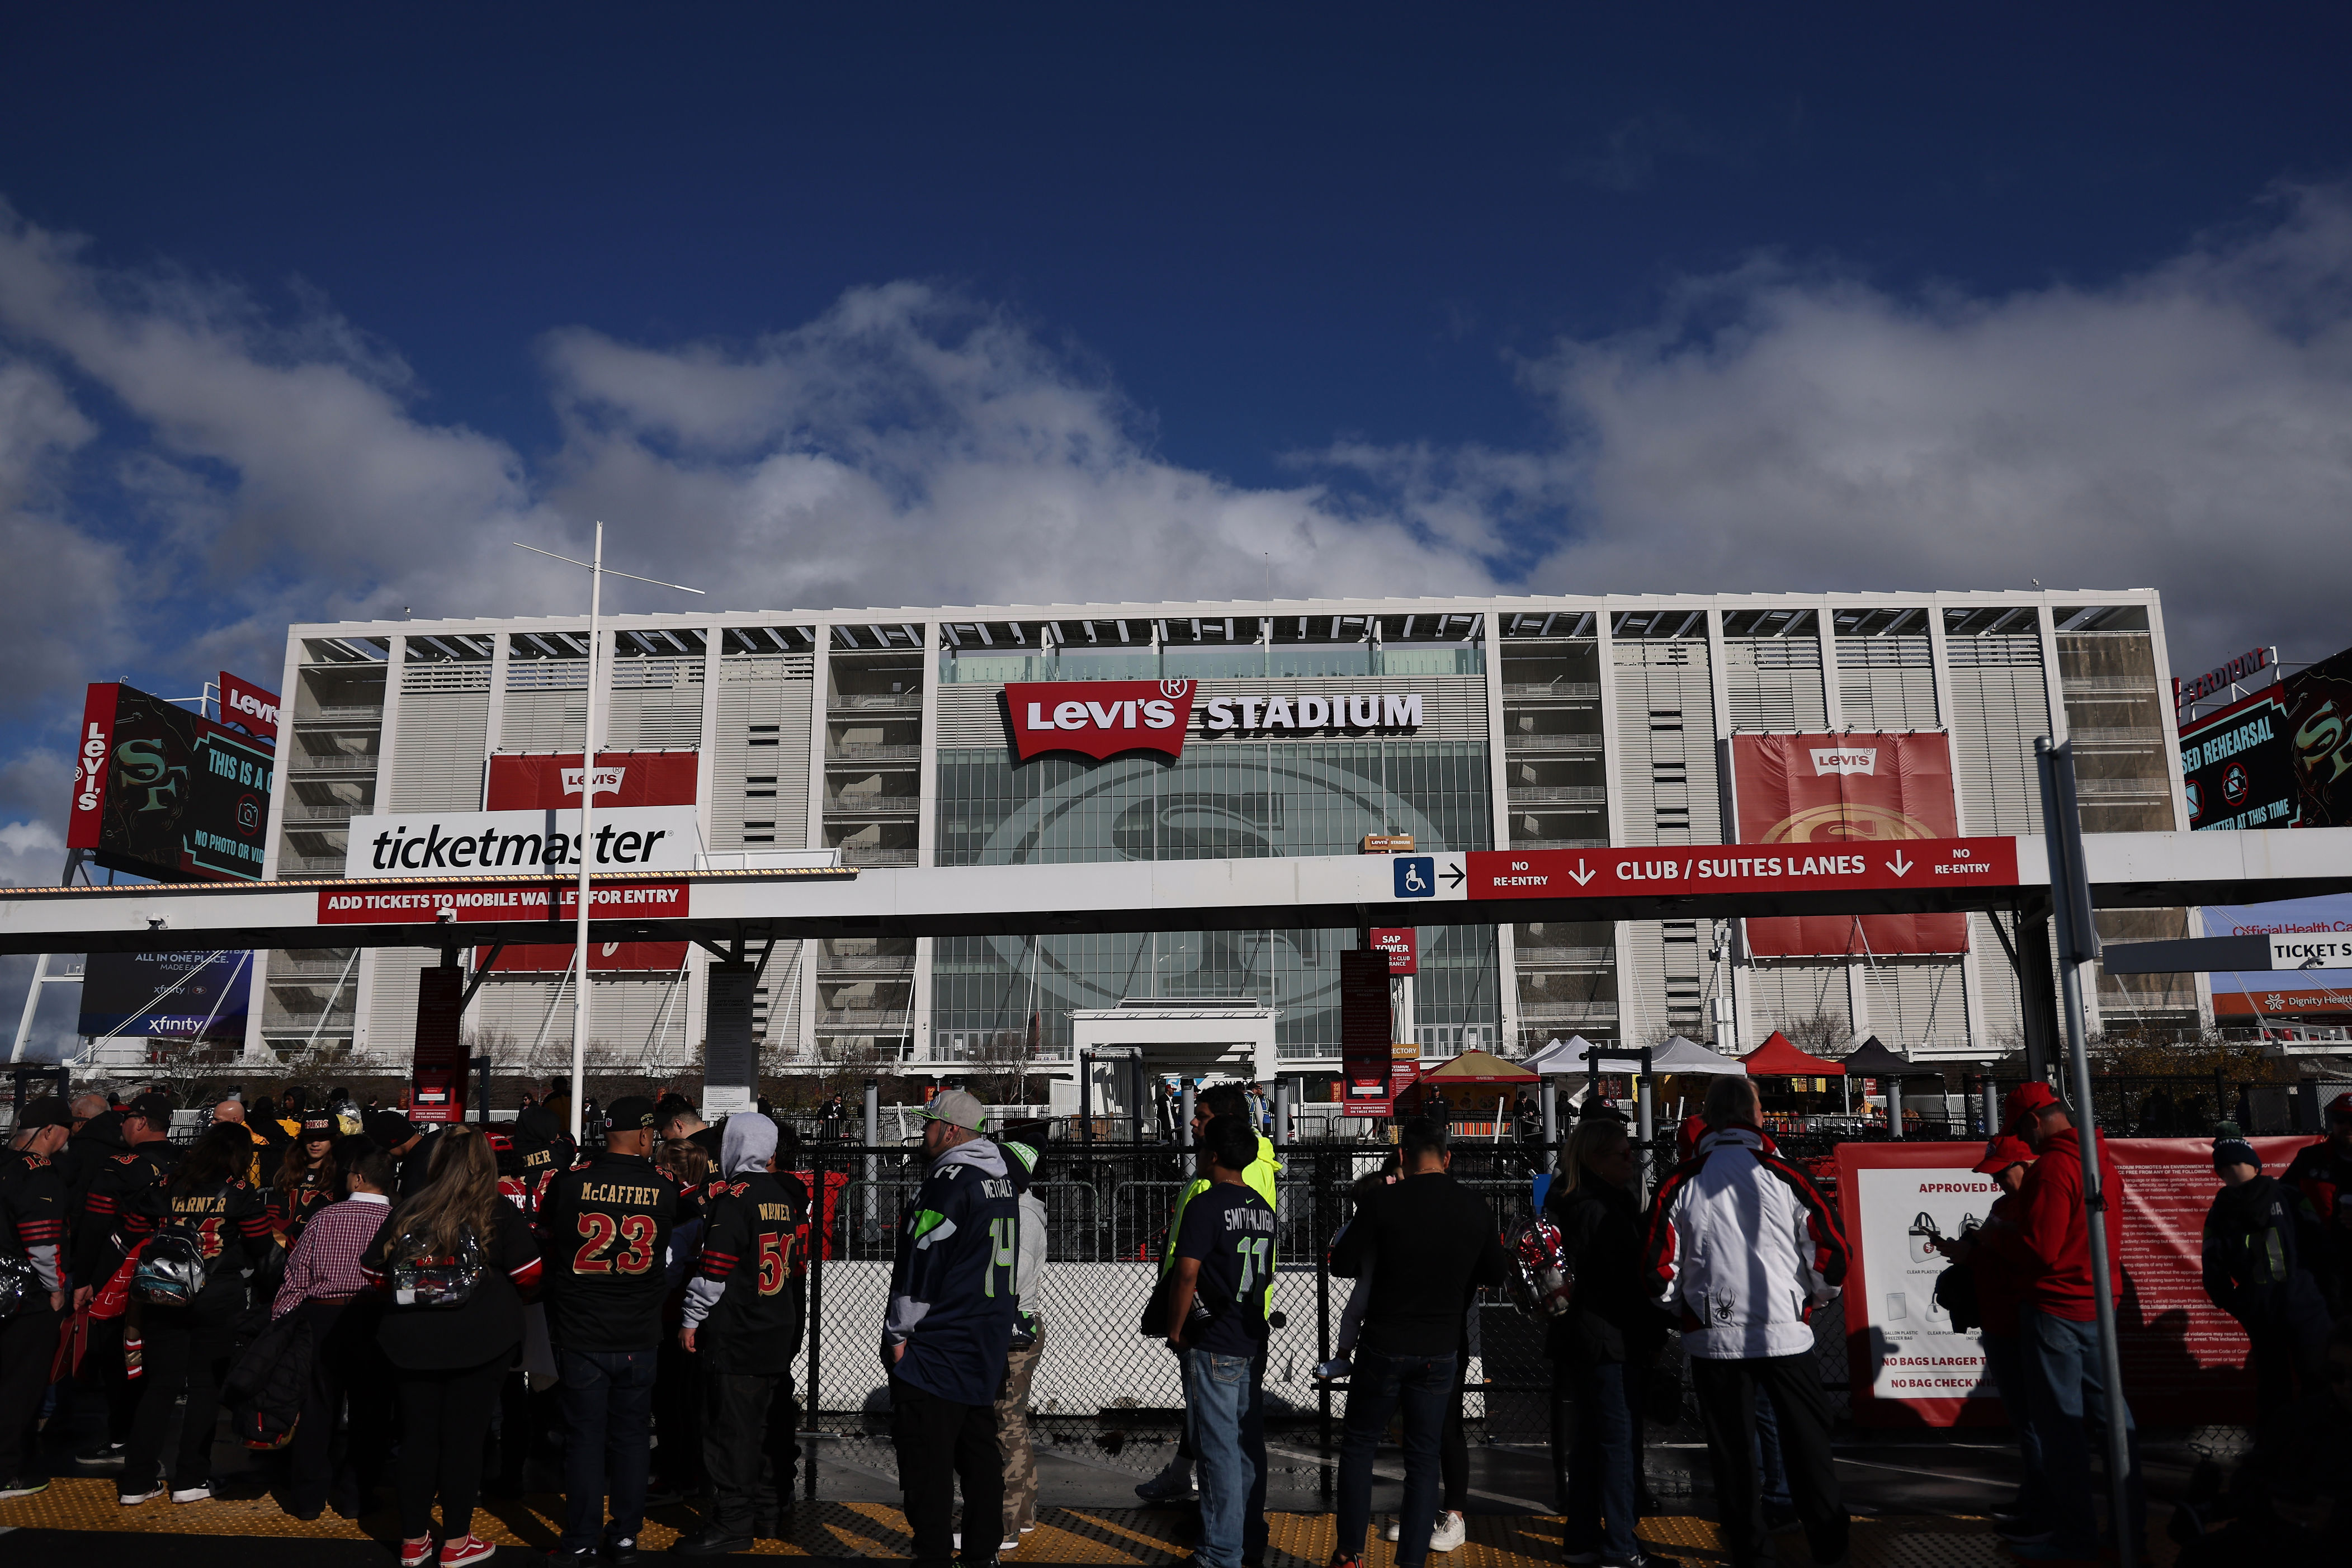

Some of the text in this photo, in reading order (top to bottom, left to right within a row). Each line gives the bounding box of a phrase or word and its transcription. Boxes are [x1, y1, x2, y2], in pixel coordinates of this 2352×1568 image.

[2181, 648, 2265, 703] STADIUM
[1207, 693, 1423, 730] STADIUM
[2203, 716, 2274, 766] REHEARSAL
[209, 748, 237, 780] THIS
[239, 760, 252, 786] IS
[254, 766, 263, 791] A
[2237, 798, 2290, 828] AT THIS TIME
[195, 829, 208, 847] NO
[209, 834, 237, 856] PHOTO
[238, 840, 249, 861] OR
[1953, 849, 1970, 858] NO
[1512, 861, 1529, 871] NO
[1616, 861, 1678, 880] CLUB
[1698, 858, 1782, 879] SUITES
[1787, 855, 1865, 876] LANES
[1934, 863, 1990, 874] RE-ENTRY
[1493, 876, 1548, 886] RE-ENTRY
[328, 896, 362, 909] ADD
[365, 894, 430, 909] TICKETS
[432, 894, 454, 907] TO
[456, 892, 518, 907] MOBILE
[588, 890, 621, 904] FOR
[624, 889, 679, 904] ENTRY
[2233, 924, 2282, 936] Official
[2285, 922, 2330, 934] Health
[170, 954, 191, 962] ONE
[2274, 944, 2336, 957] TICKET
[2288, 996, 2322, 1007] Dignity
[148, 1016, 204, 1034] xfinity
[581, 1182, 660, 1206] McCAFFREY
[1919, 1183, 1988, 1193] APPROVED
[573, 1211, 658, 1276] 23
[984, 1217, 1016, 1298] 14
[1236, 1236, 1269, 1306] 11
[1882, 1358, 1897, 1366] NO
[1900, 1357, 1929, 1366] BAGS
[1932, 1357, 1977, 1366] LARGER
